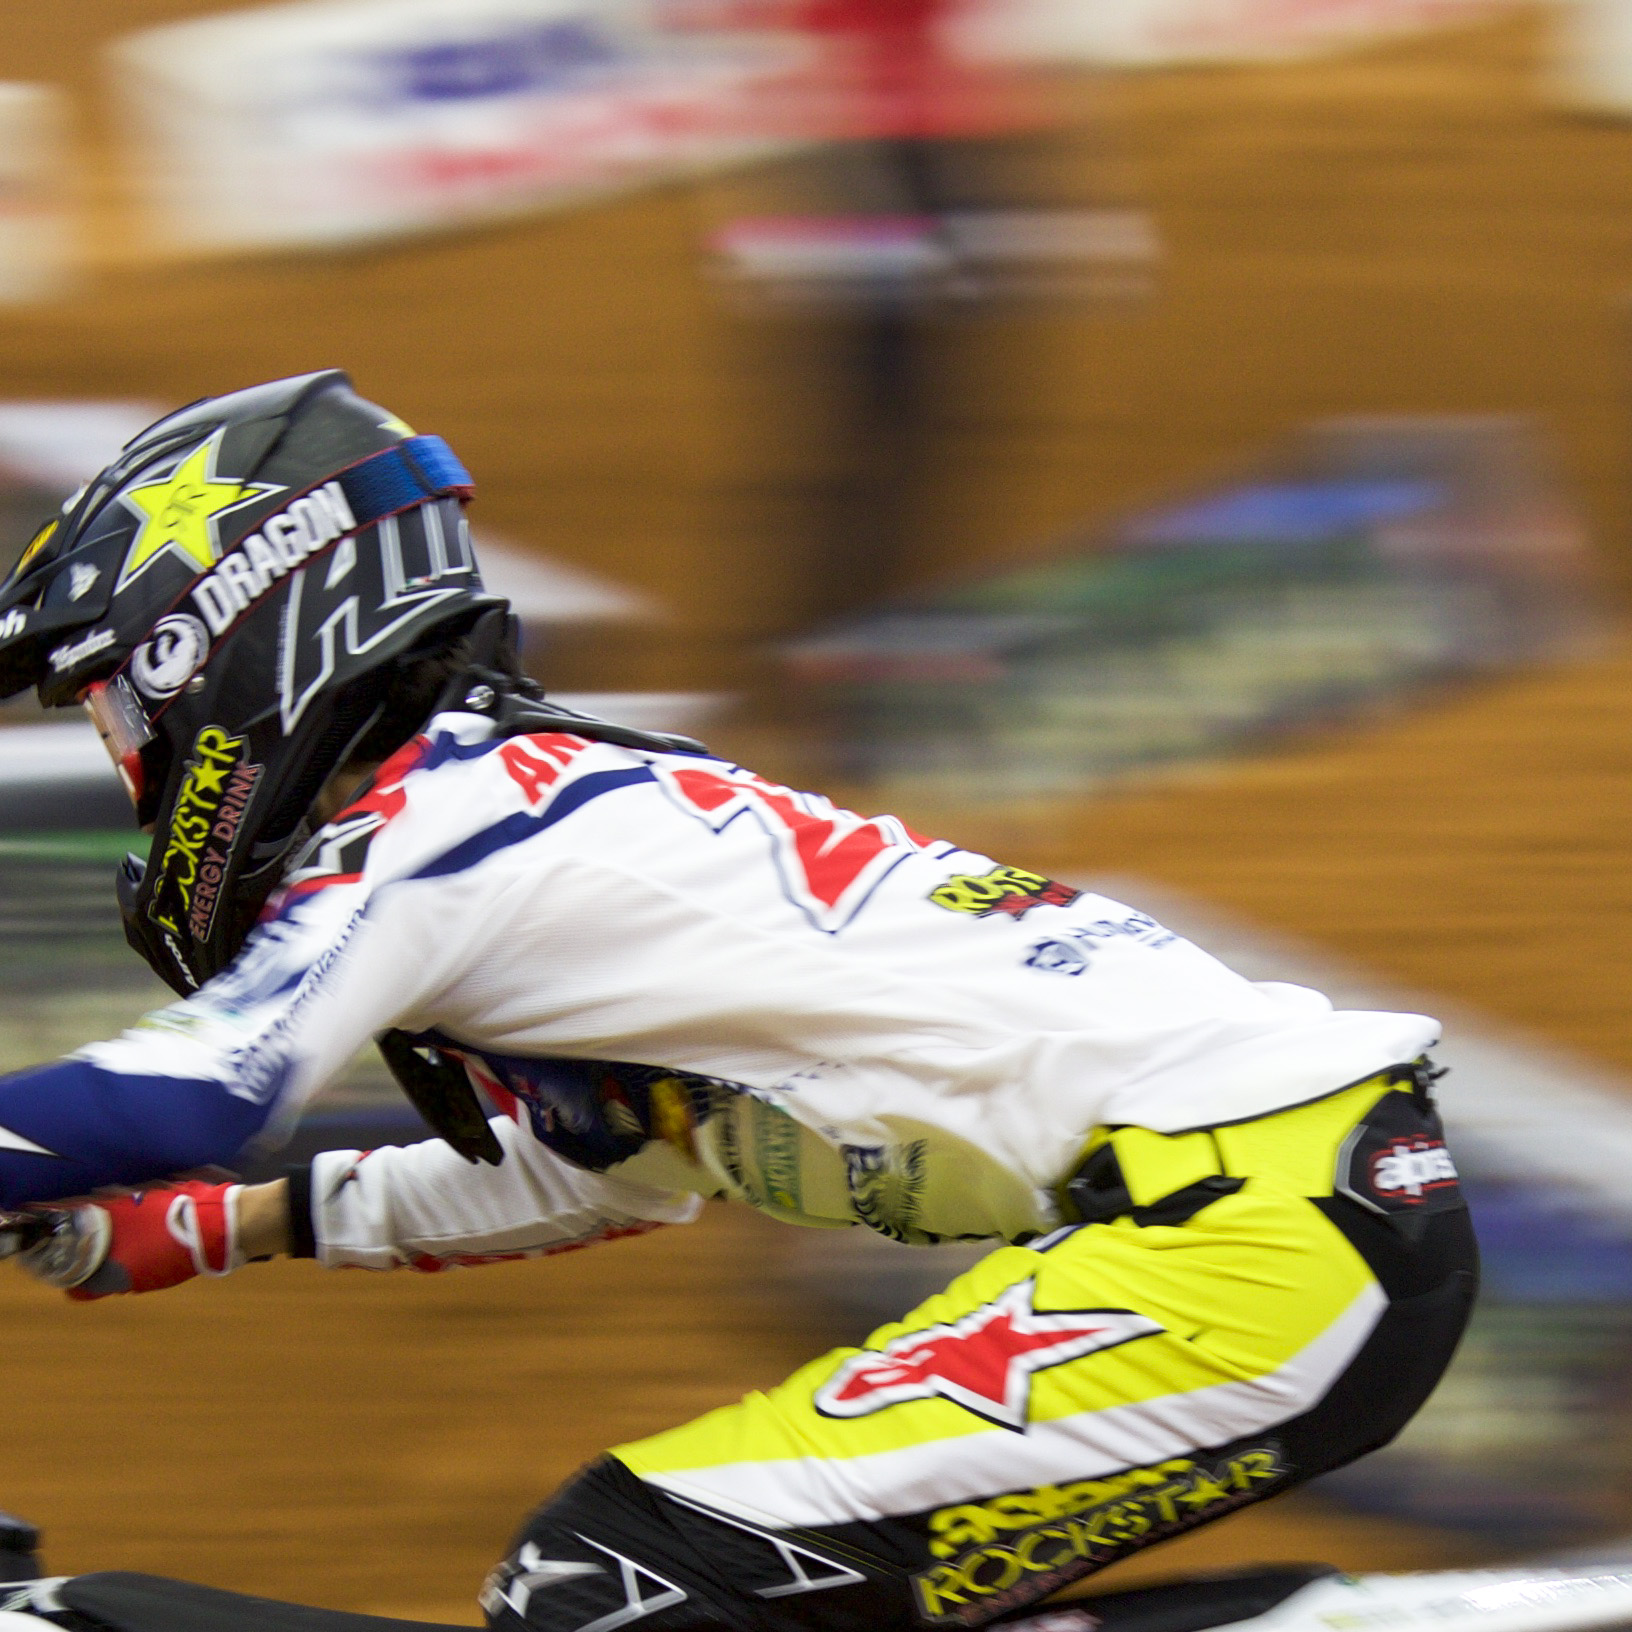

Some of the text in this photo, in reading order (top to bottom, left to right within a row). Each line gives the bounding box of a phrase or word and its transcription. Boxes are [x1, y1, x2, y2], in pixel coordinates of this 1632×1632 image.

[191, 481, 357, 638] DRAGON
[187, 762, 260, 939] ENERGY DRINK
